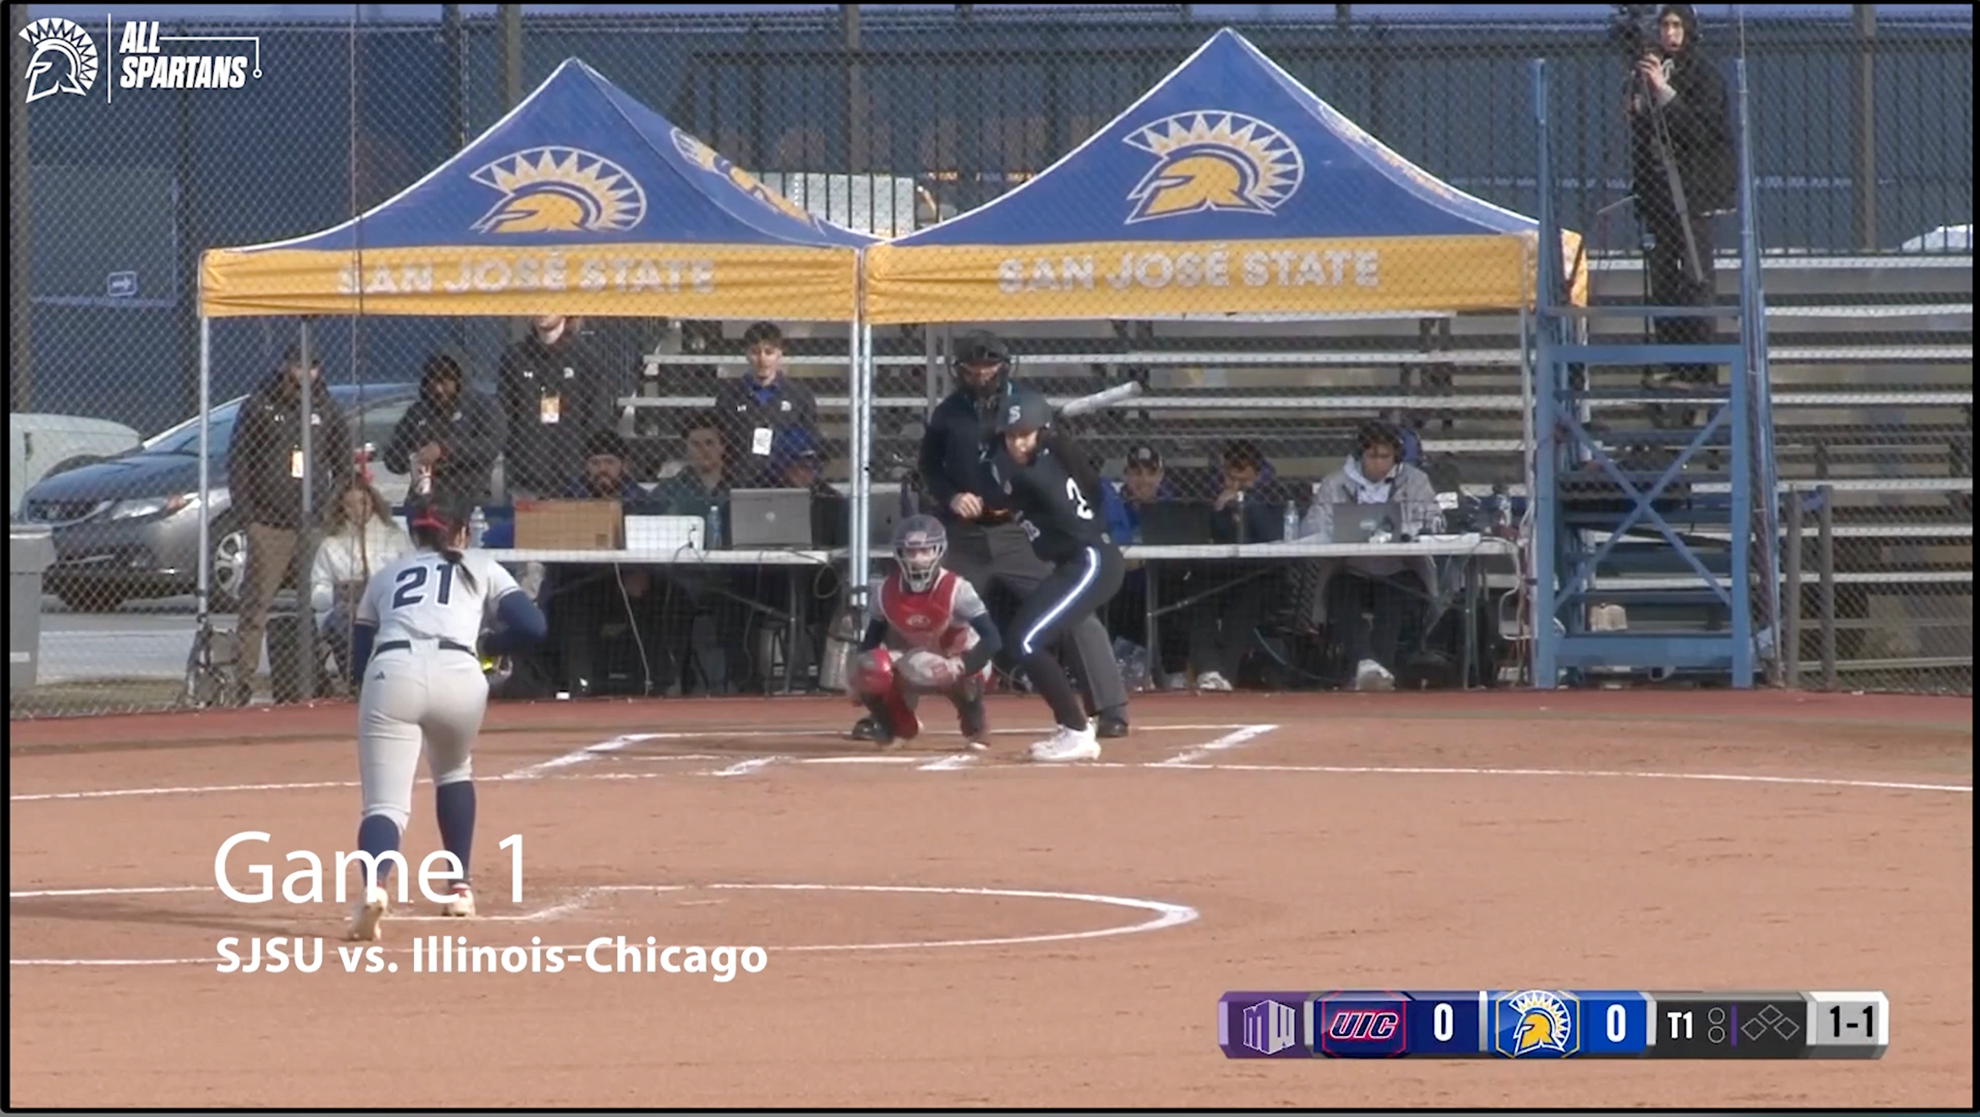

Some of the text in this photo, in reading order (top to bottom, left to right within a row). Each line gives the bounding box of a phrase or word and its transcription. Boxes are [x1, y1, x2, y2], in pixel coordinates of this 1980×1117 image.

[337, 250, 715, 294] SAN JOSÉ STATE
[998, 242, 1380, 294] SAN JOSÉ STATE
[392, 563, 454, 609] 21
